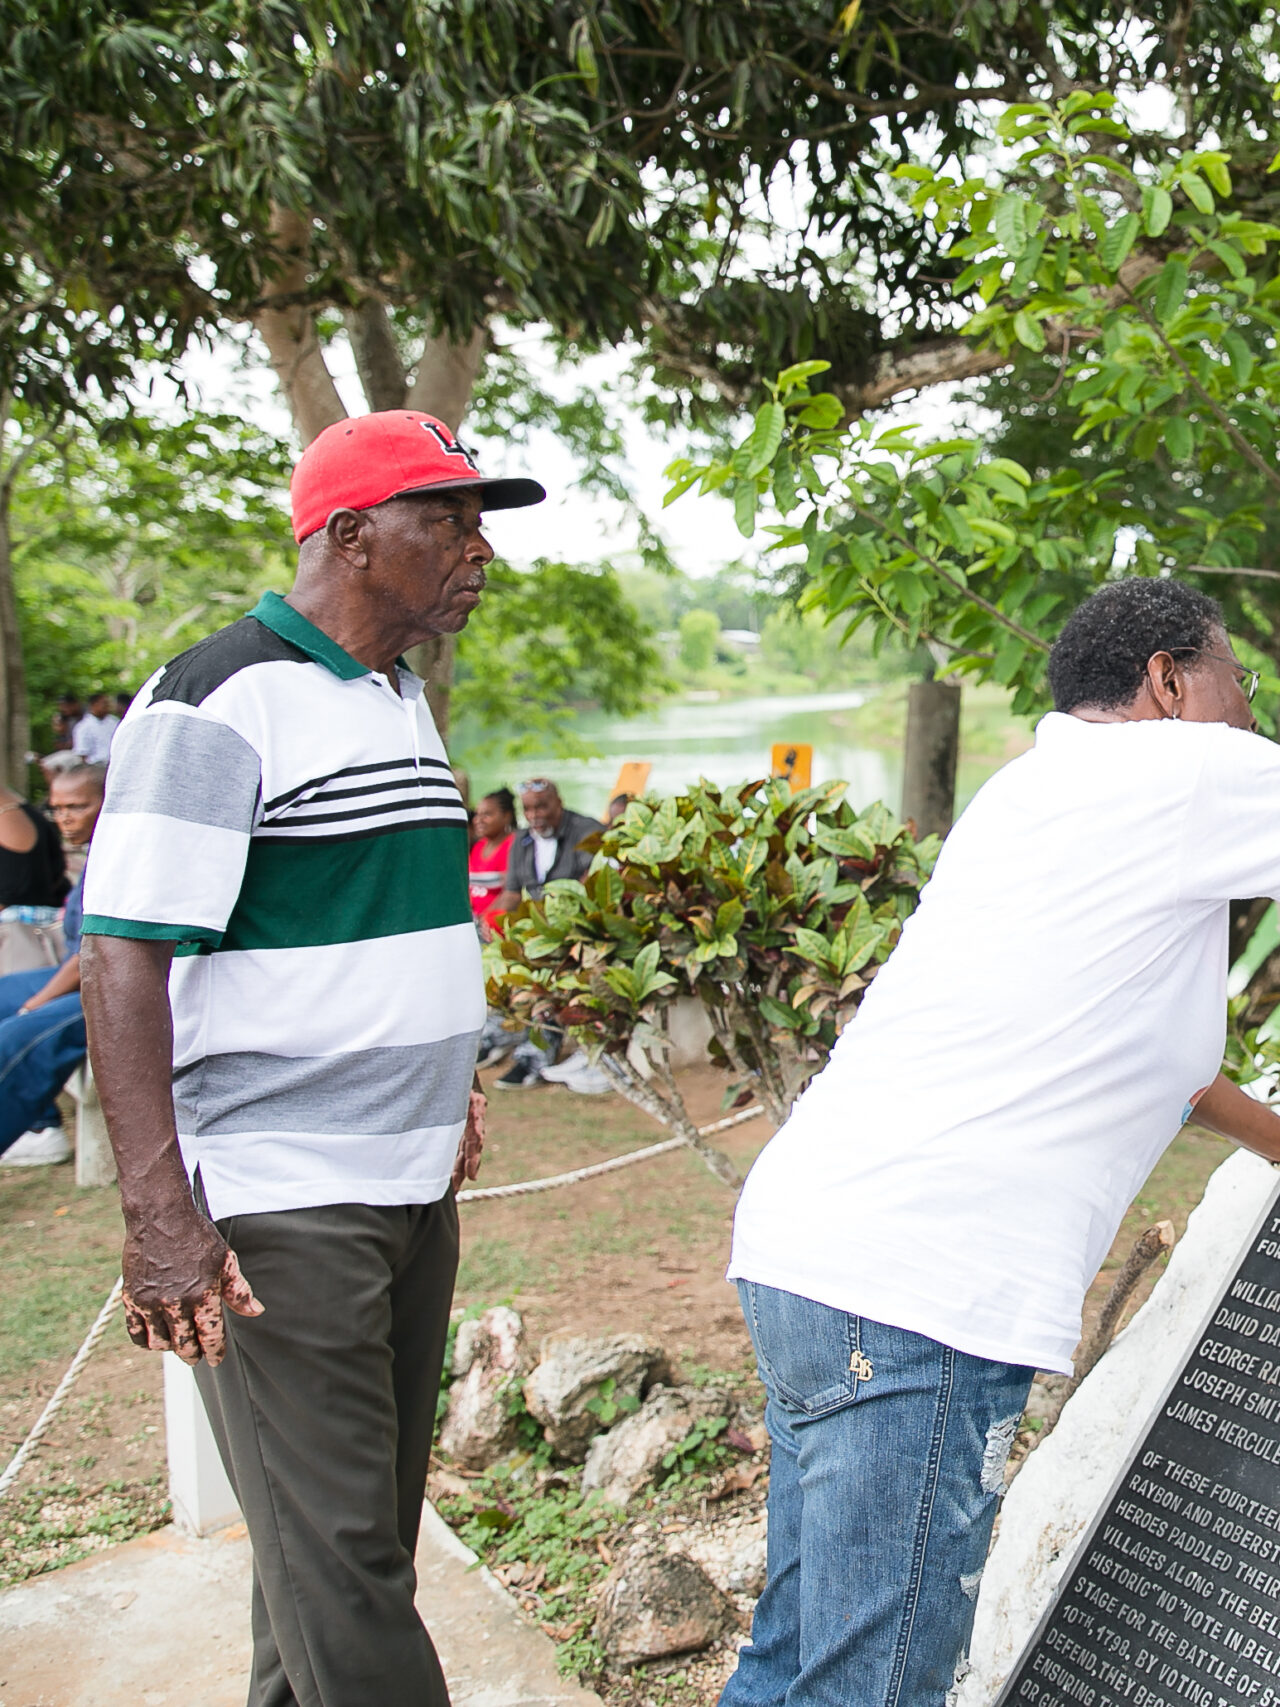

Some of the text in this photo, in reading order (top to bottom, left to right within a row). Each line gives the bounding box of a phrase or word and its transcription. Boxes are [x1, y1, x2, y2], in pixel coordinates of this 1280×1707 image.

[1214, 1307, 1259, 1336] DAVID
[1199, 1339, 1260, 1375] GEORGE
[1183, 1368, 1247, 1406] JOSEPH
[1166, 1400, 1218, 1433] JAMES
[1142, 1451, 1163, 1468] OF
[1164, 1460, 1211, 1494] THESE
[1129, 1474, 1183, 1512] RAYBON
[1181, 1502, 1213, 1527] AND
[1115, 1499, 1169, 1538] HEROES
[1167, 1526, 1233, 1571] PADDLED
[1235, 1561, 1280, 1598] THEIR
[1103, 1525, 1167, 1571] VILLAGES
[1164, 1561, 1214, 1597] ALONG
[1217, 1587, 1250, 1617] THE
[1074, 1576, 1119, 1613] STAGE
[1117, 1603, 1146, 1631] FOR
[1147, 1620, 1177, 1650] THE
[1176, 1639, 1238, 1687] BATTLE
[1236, 1674, 1261, 1697] OF
[1223, 1628, 1244, 1651] IN
[1020, 1679, 1040, 1702] OR
[1033, 1653, 1096, 1706] ENSURING
[1134, 1649, 1159, 1673] BY
[1158, 1664, 1213, 1707] VOTING
